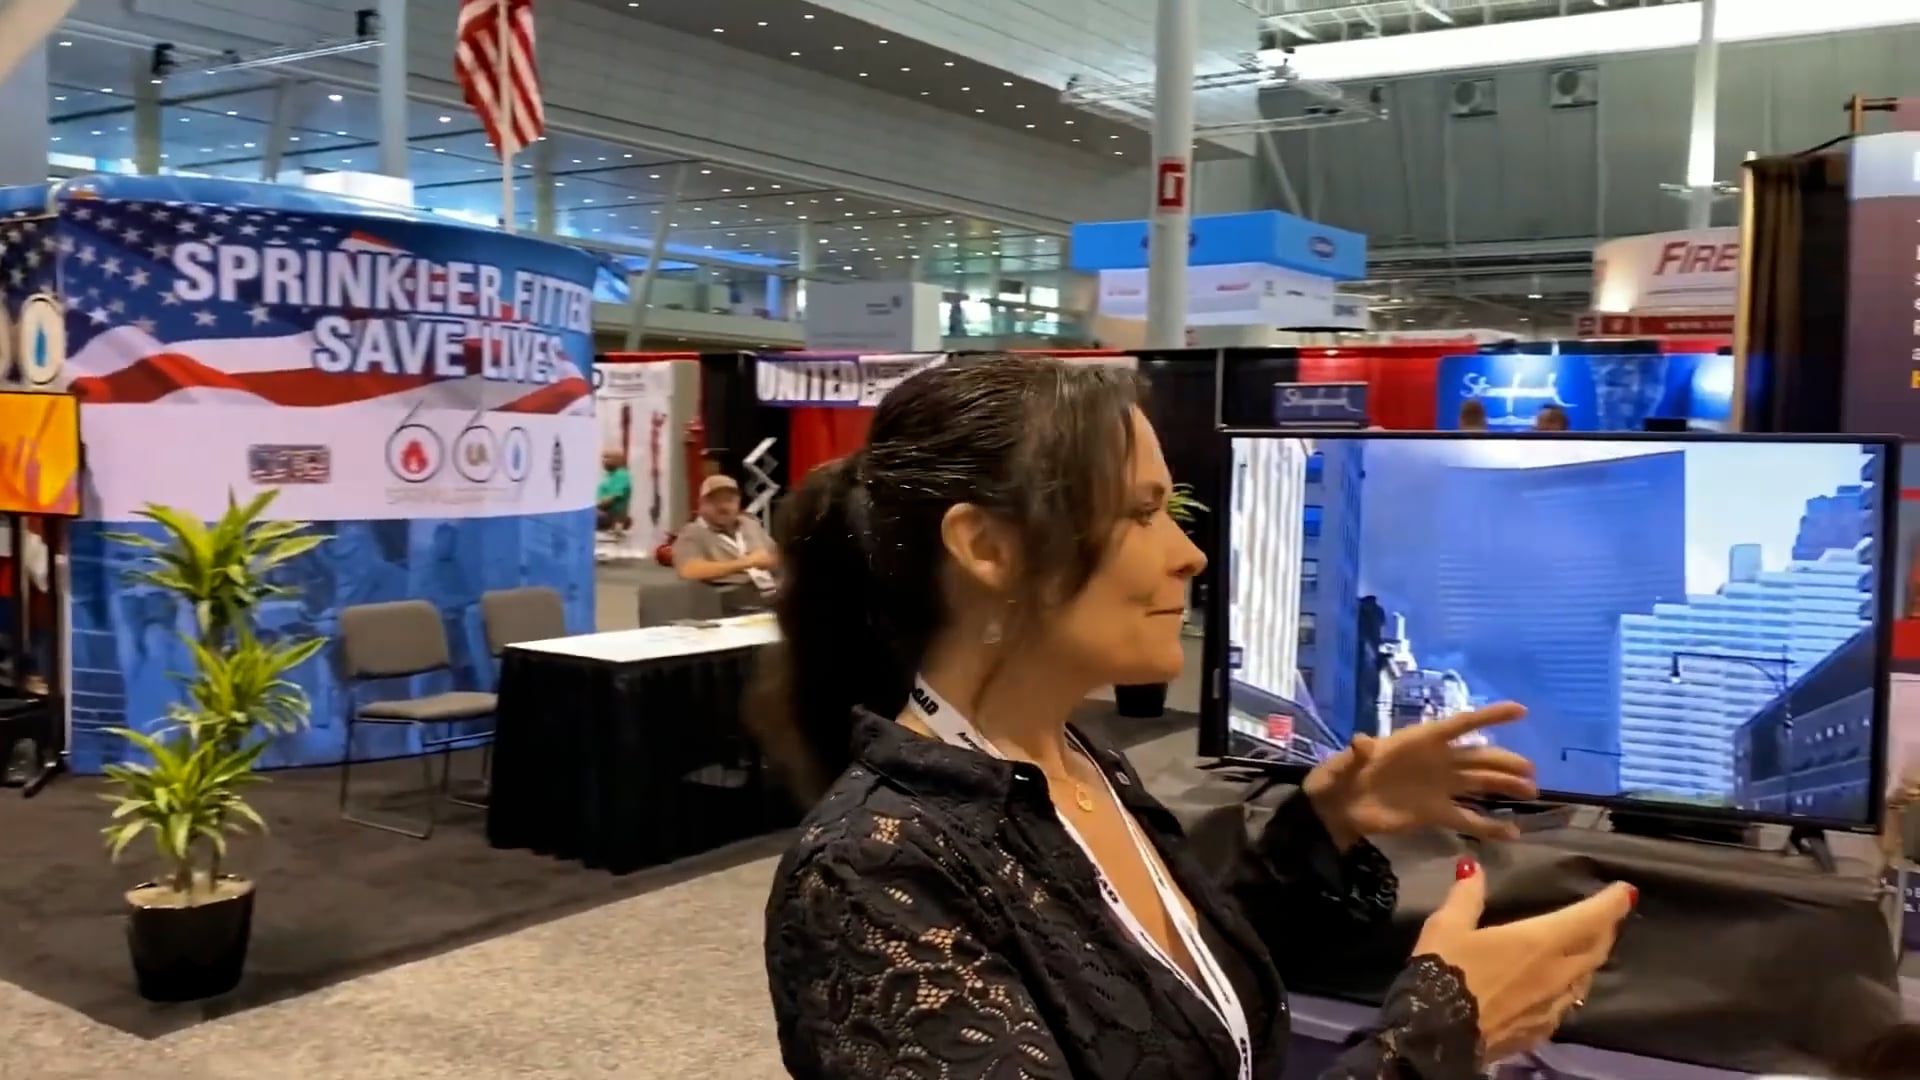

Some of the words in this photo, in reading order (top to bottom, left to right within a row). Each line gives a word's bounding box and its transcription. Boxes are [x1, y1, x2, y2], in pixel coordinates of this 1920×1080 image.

[172, 240, 503, 318] SPRINKLER
[1652, 240, 1740, 276] FIRE
[314, 315, 467, 377] SAVE
[481, 322, 564, 383] LIVES
